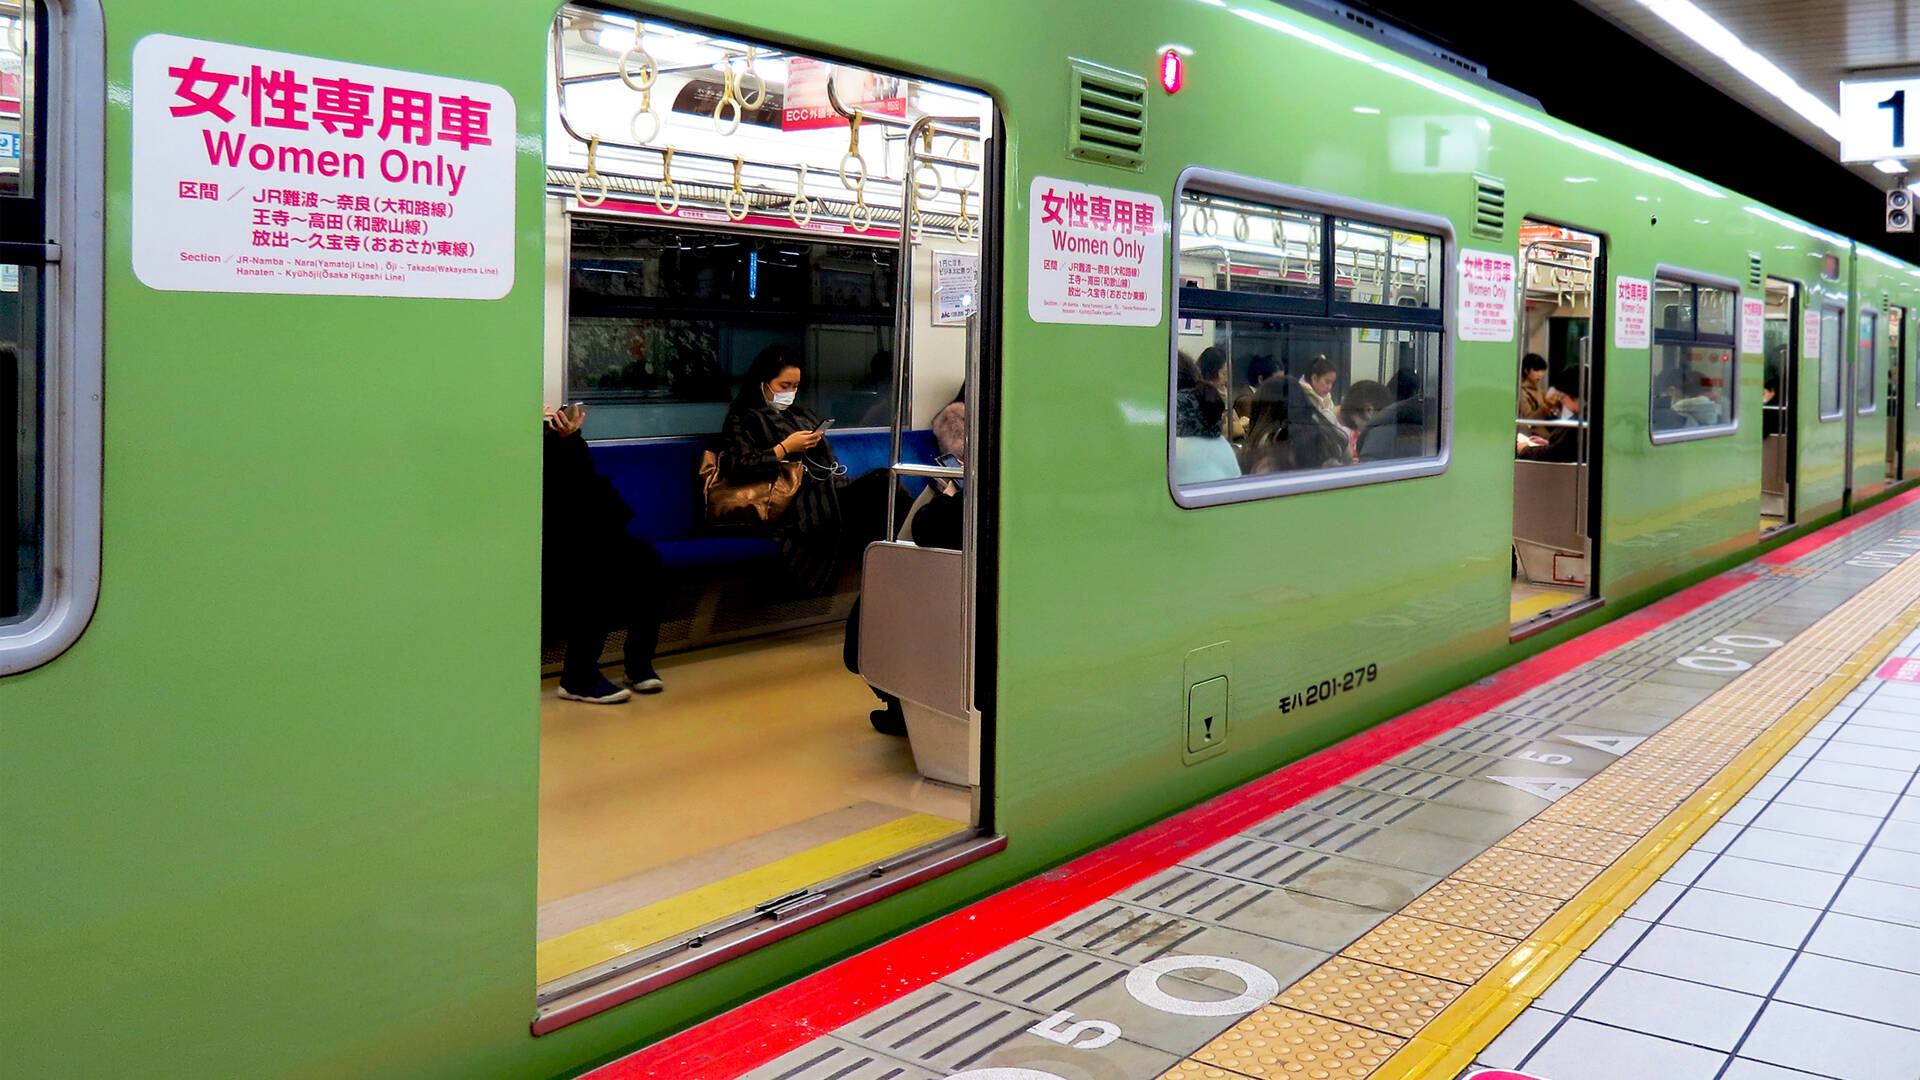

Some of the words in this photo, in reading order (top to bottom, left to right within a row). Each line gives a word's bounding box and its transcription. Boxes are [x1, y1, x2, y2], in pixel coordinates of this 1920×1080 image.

[168, 56, 492, 151] 女性専用車
[1878, 90, 1905, 148] 1
[202, 129, 364, 179] Women
[380, 149, 466, 197] Only
[178, 181, 219, 201] 区間
[1041, 188, 1155, 236] 女性専用車
[179, 251, 221, 263] Section
[236, 256, 285, 266] JR-Namba
[1052, 229, 1108, 256] Women
[1113, 237, 1145, 264] Only
[236, 267, 275, 277] Hanaten
[1464, 256, 1511, 282] 女性専用車
[1518, 750, 1573, 765] 5
[1026, 1010, 1122, 1050] 5
